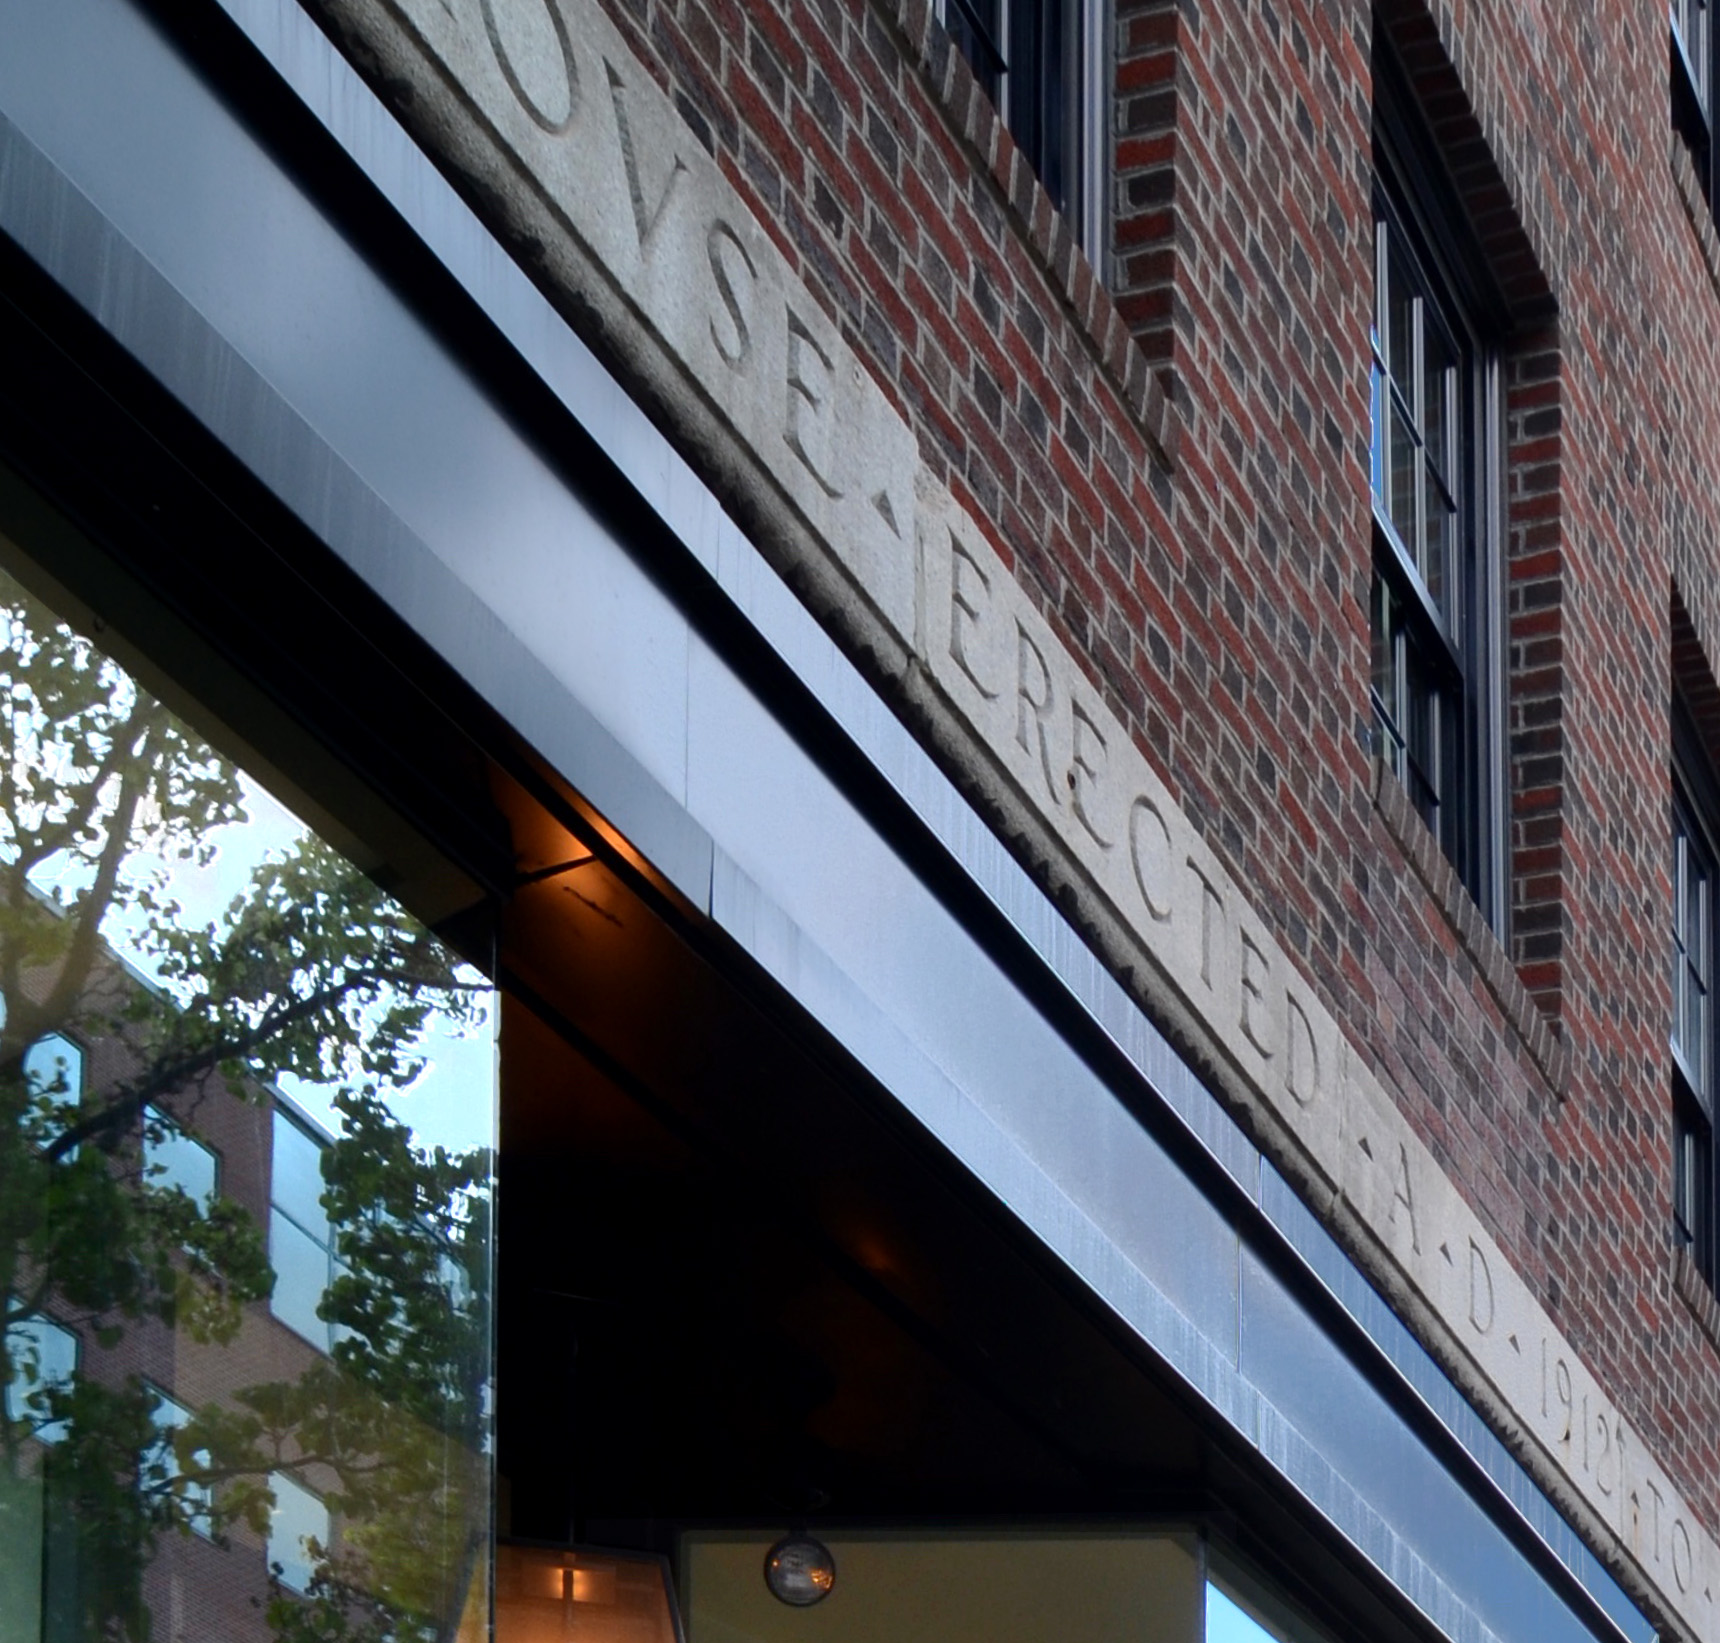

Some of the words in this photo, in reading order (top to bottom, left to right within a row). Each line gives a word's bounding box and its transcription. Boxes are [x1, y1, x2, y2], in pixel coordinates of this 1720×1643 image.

[440, 0, 844, 501] OVSE
[950, 527, 1319, 1108] ERECTED
[1646, 1477, 1693, 1595] TO
